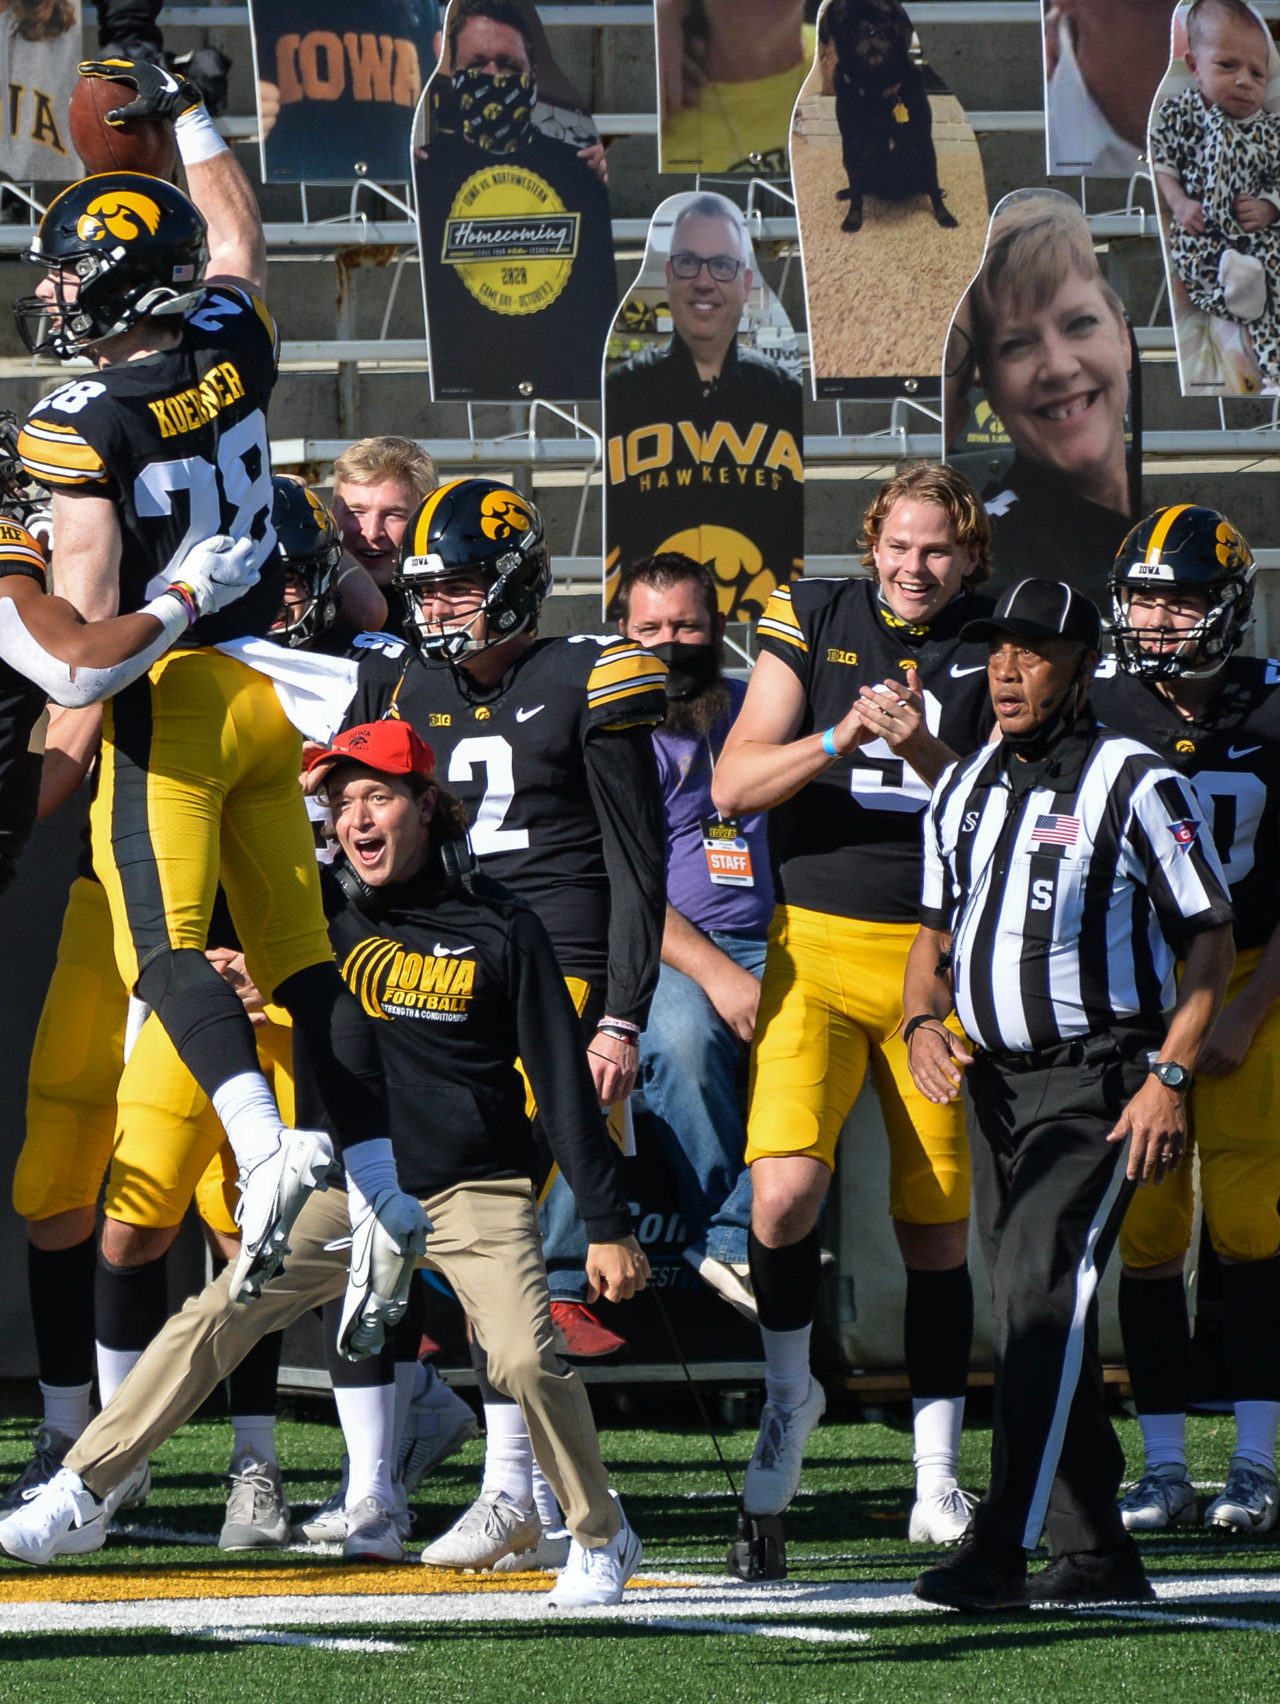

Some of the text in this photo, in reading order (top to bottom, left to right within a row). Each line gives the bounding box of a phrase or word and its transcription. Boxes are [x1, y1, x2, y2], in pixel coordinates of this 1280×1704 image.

[276, 31, 421, 108] IOWA
[454, 221, 567, 253] Homecoming
[148, 361, 246, 438] KOERNER
[608, 420, 805, 486] IOWA
[639, 466, 782, 492] HAWKEYES
[134, 408, 278, 600] 28
[411, 558, 429, 566] IOWA
[1138, 565, 1161, 575] IOWA
[448, 735, 530, 856] 2
[961, 811, 980, 833] S
[710, 854, 748, 871] STAFF
[1030, 879, 1054, 911] S
[386, 951, 476, 995] IOWA
[382, 990, 467, 1012] FOOTBALL
